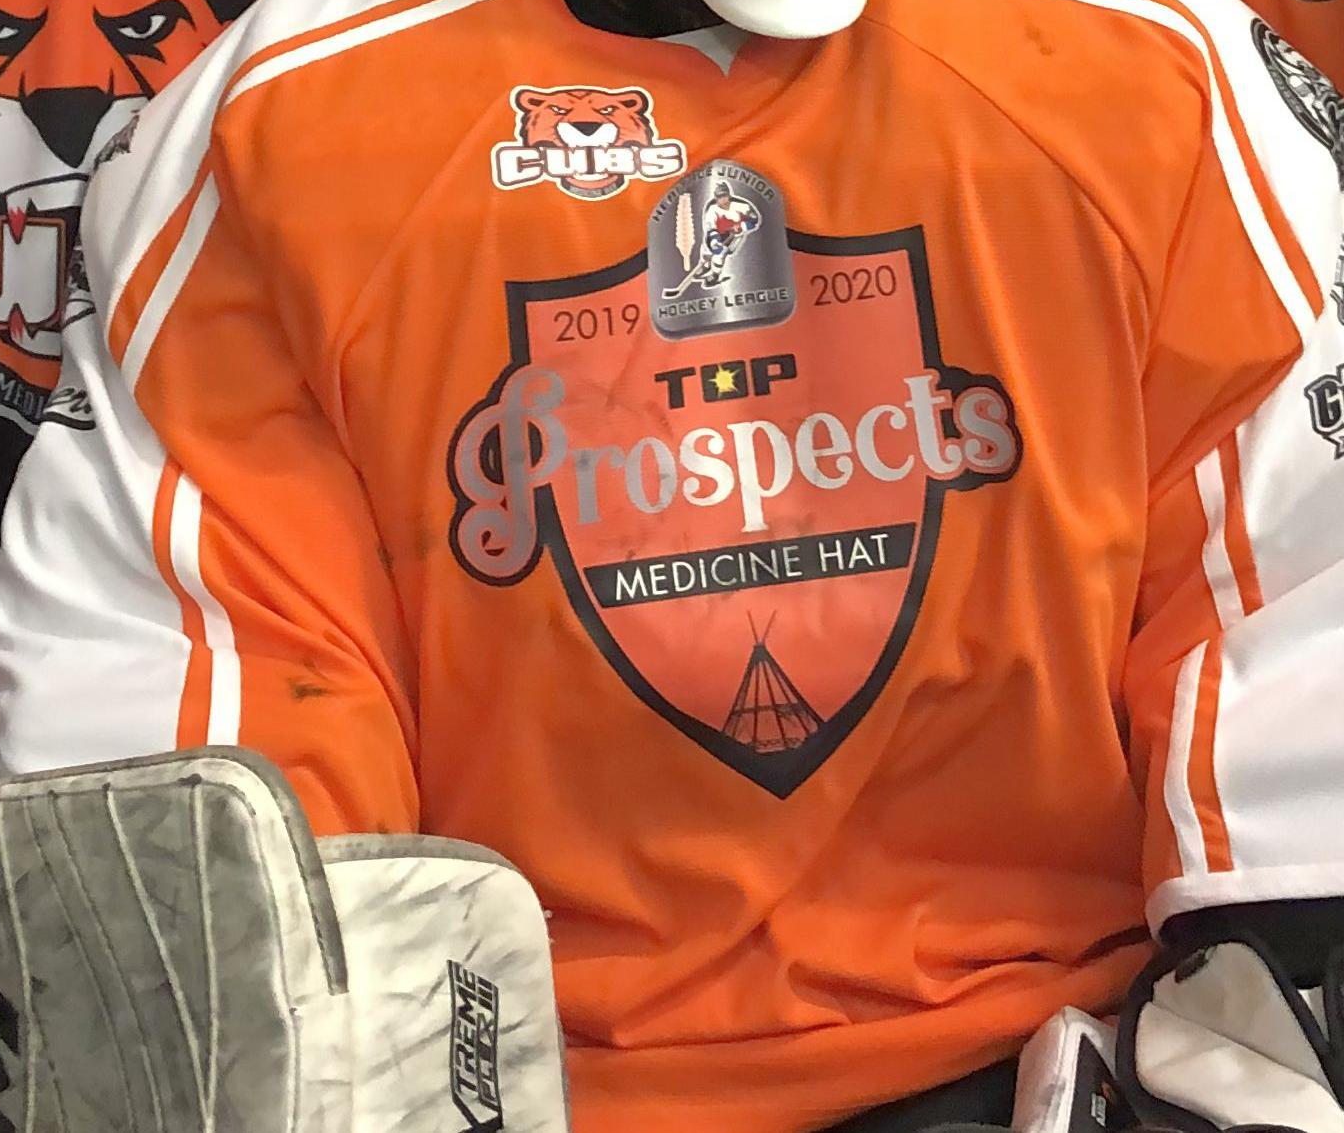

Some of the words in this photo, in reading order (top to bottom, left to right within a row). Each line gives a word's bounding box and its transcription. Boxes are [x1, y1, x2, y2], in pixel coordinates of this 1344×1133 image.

[496, 143, 683, 187] CUBS
[725, 288, 789, 307] LEAGUE
[811, 264, 898, 307] 2020
[553, 303, 640, 343] 2019
[655, 354, 797, 410] TOP
[457, 367, 1016, 574] Prospects
[615, 544, 802, 602] MEDICINE
[818, 533, 889, 574] HAT
